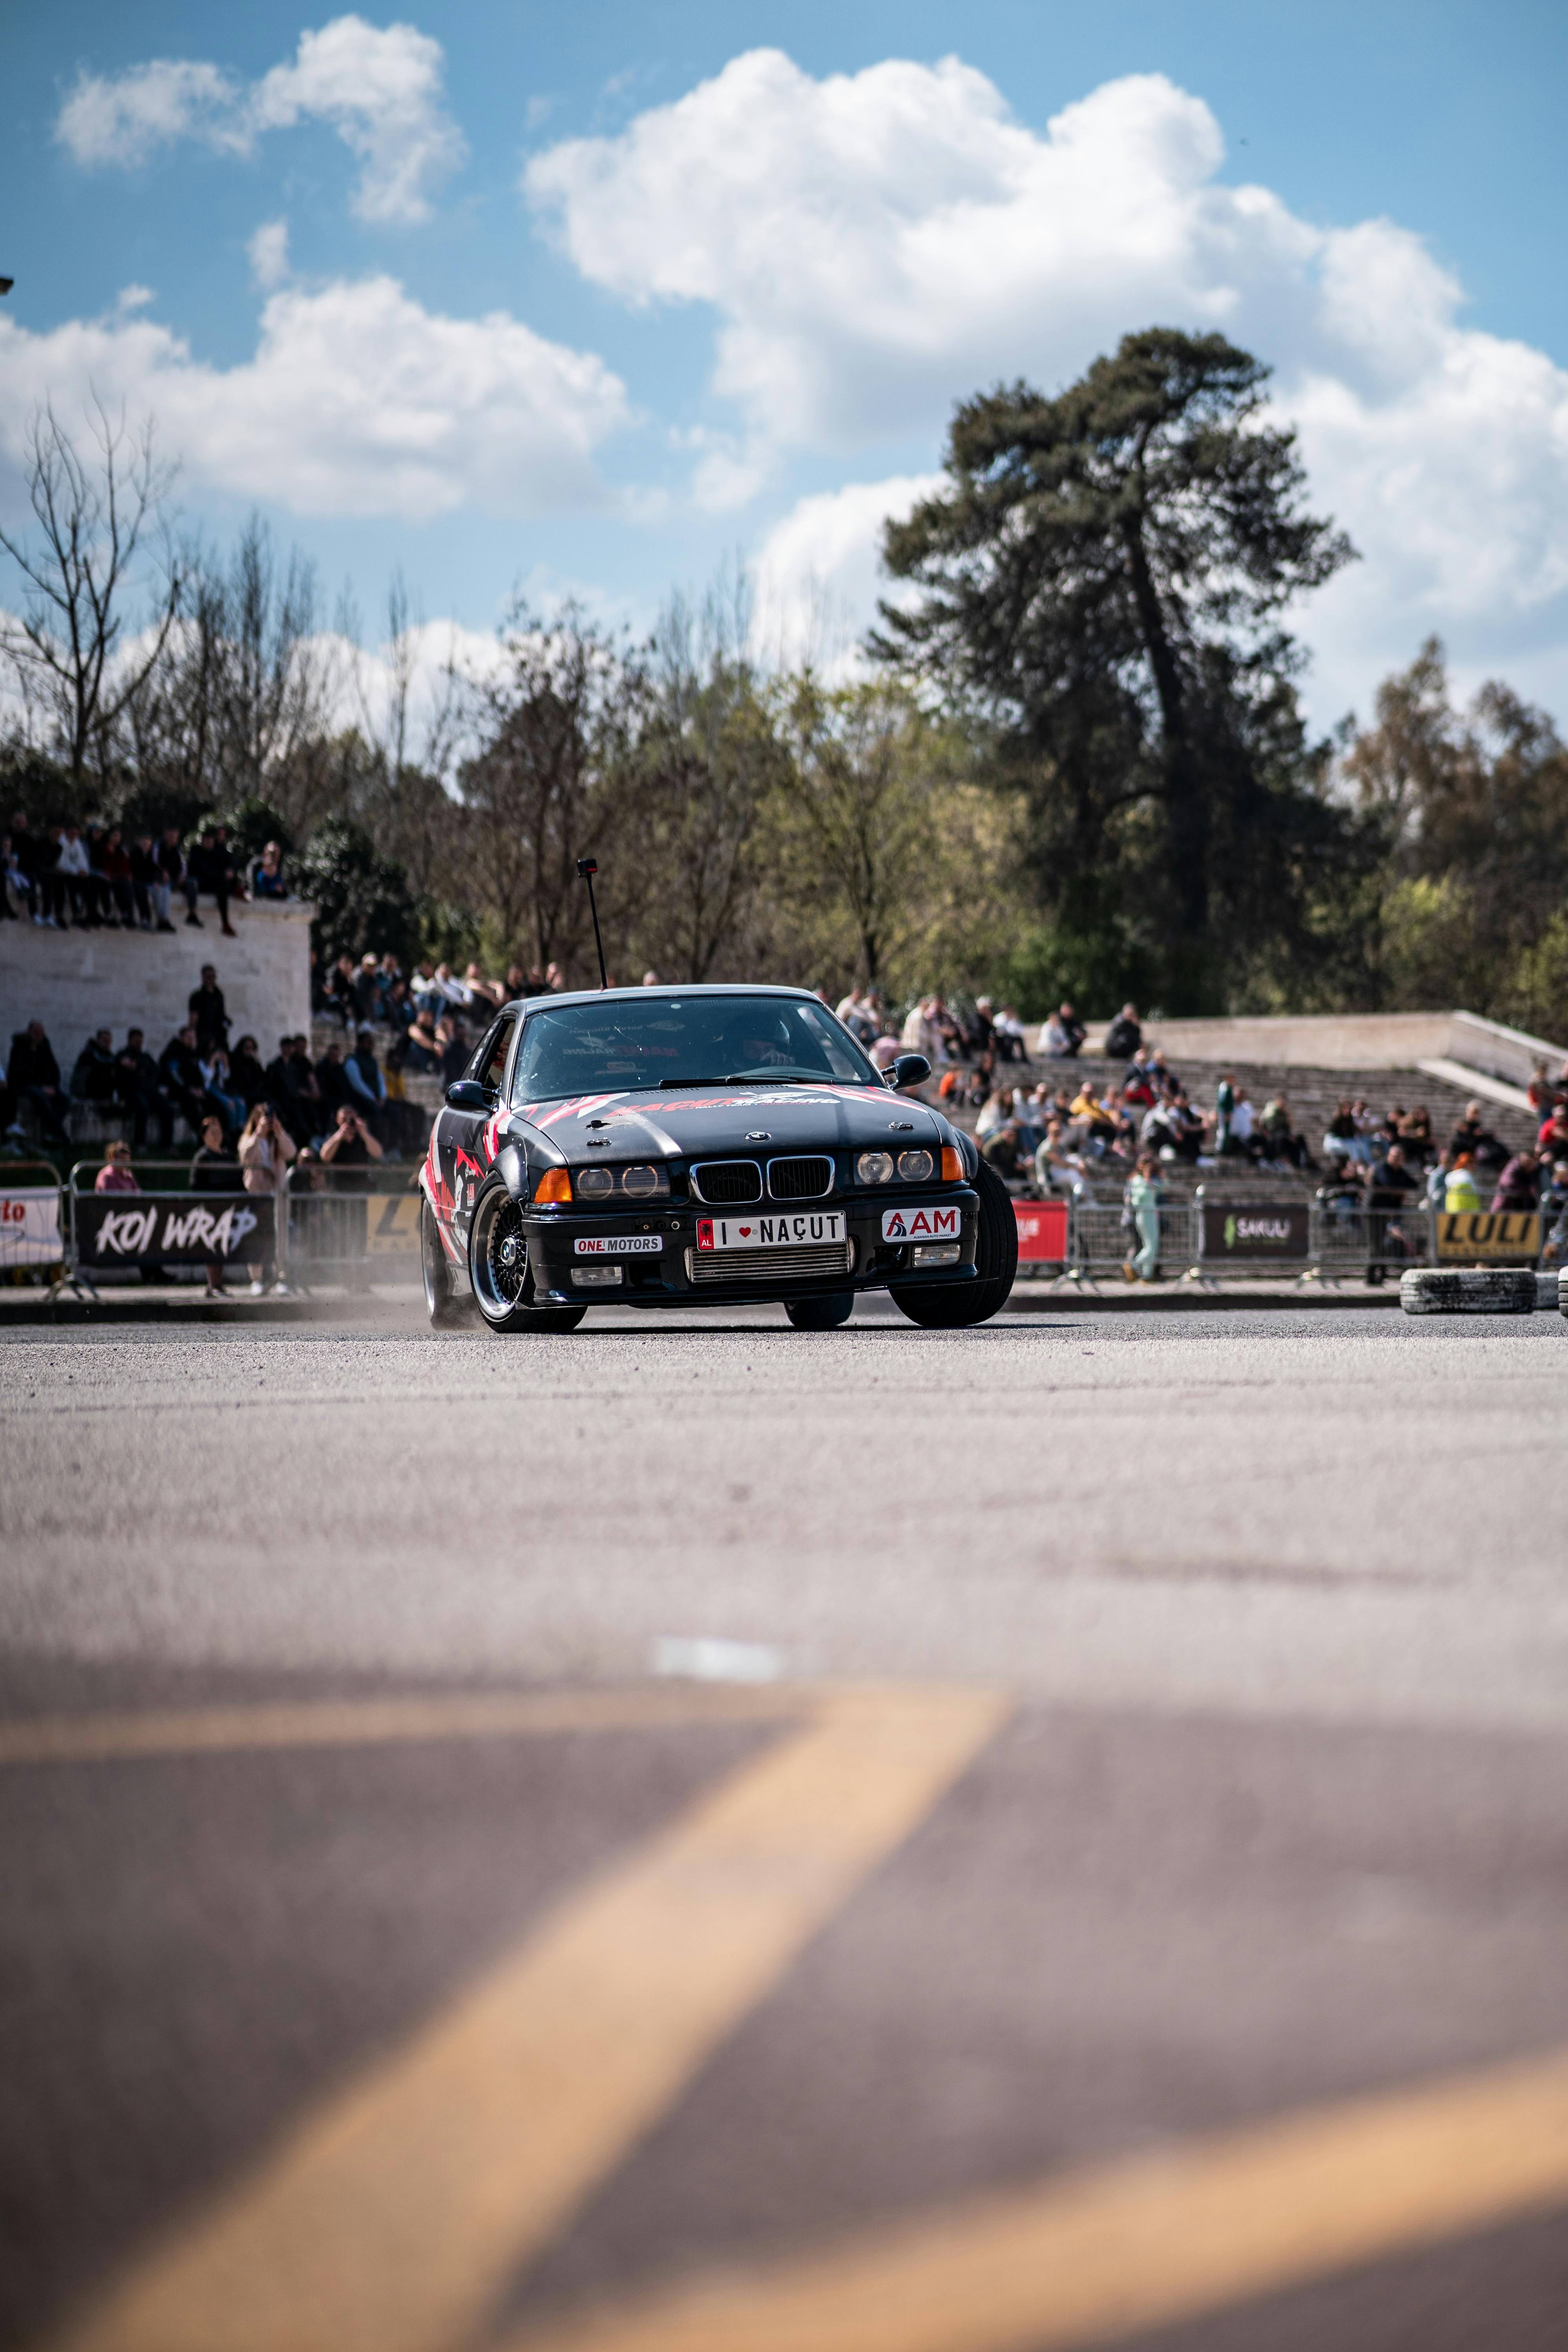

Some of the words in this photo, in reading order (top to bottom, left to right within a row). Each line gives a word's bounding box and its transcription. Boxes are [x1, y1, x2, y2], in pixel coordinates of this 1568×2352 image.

[0, 1199, 25, 1223] to
[95, 1205, 158, 1256] KOI
[161, 1204, 257, 1257] WRAP
[721, 1222, 727, 1245] I
[760, 1215, 839, 1243] NAÇUT
[1444, 1214, 1532, 1243] LULI
[607, 1238, 658, 1251] MOTORS
